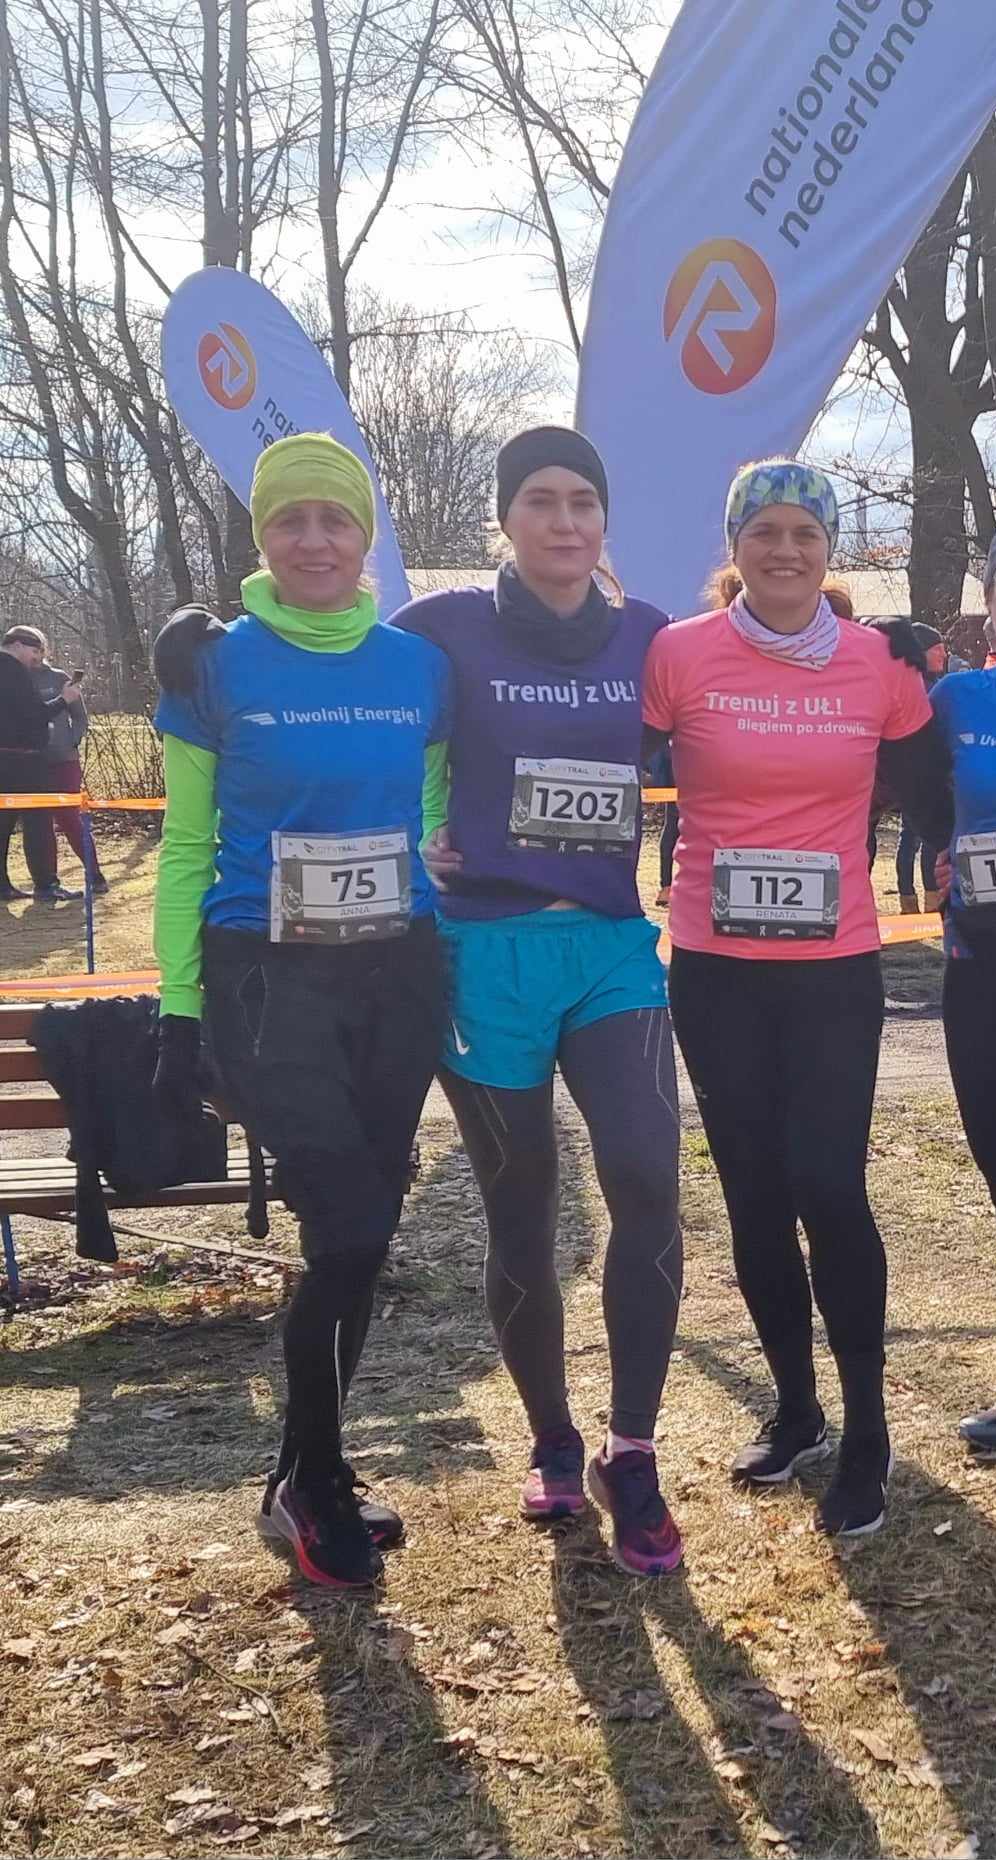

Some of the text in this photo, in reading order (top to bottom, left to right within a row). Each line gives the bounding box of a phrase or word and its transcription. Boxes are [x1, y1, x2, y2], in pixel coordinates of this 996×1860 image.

[490, 680, 637, 708] Trenuj z UŁ!
[704, 692, 843, 718] Trenuj z UŁ!
[282, 706, 421, 726] Uwolnij Energię!
[737, 718, 793, 734] Biegiem
[796, 722, 814, 736] po
[536, 787, 619, 822] 1203
[330, 867, 377, 902] 75
[750, 875, 803, 906] 112
[340, 906, 370, 916] ANNA
[755, 909, 798, 920] RENATA
